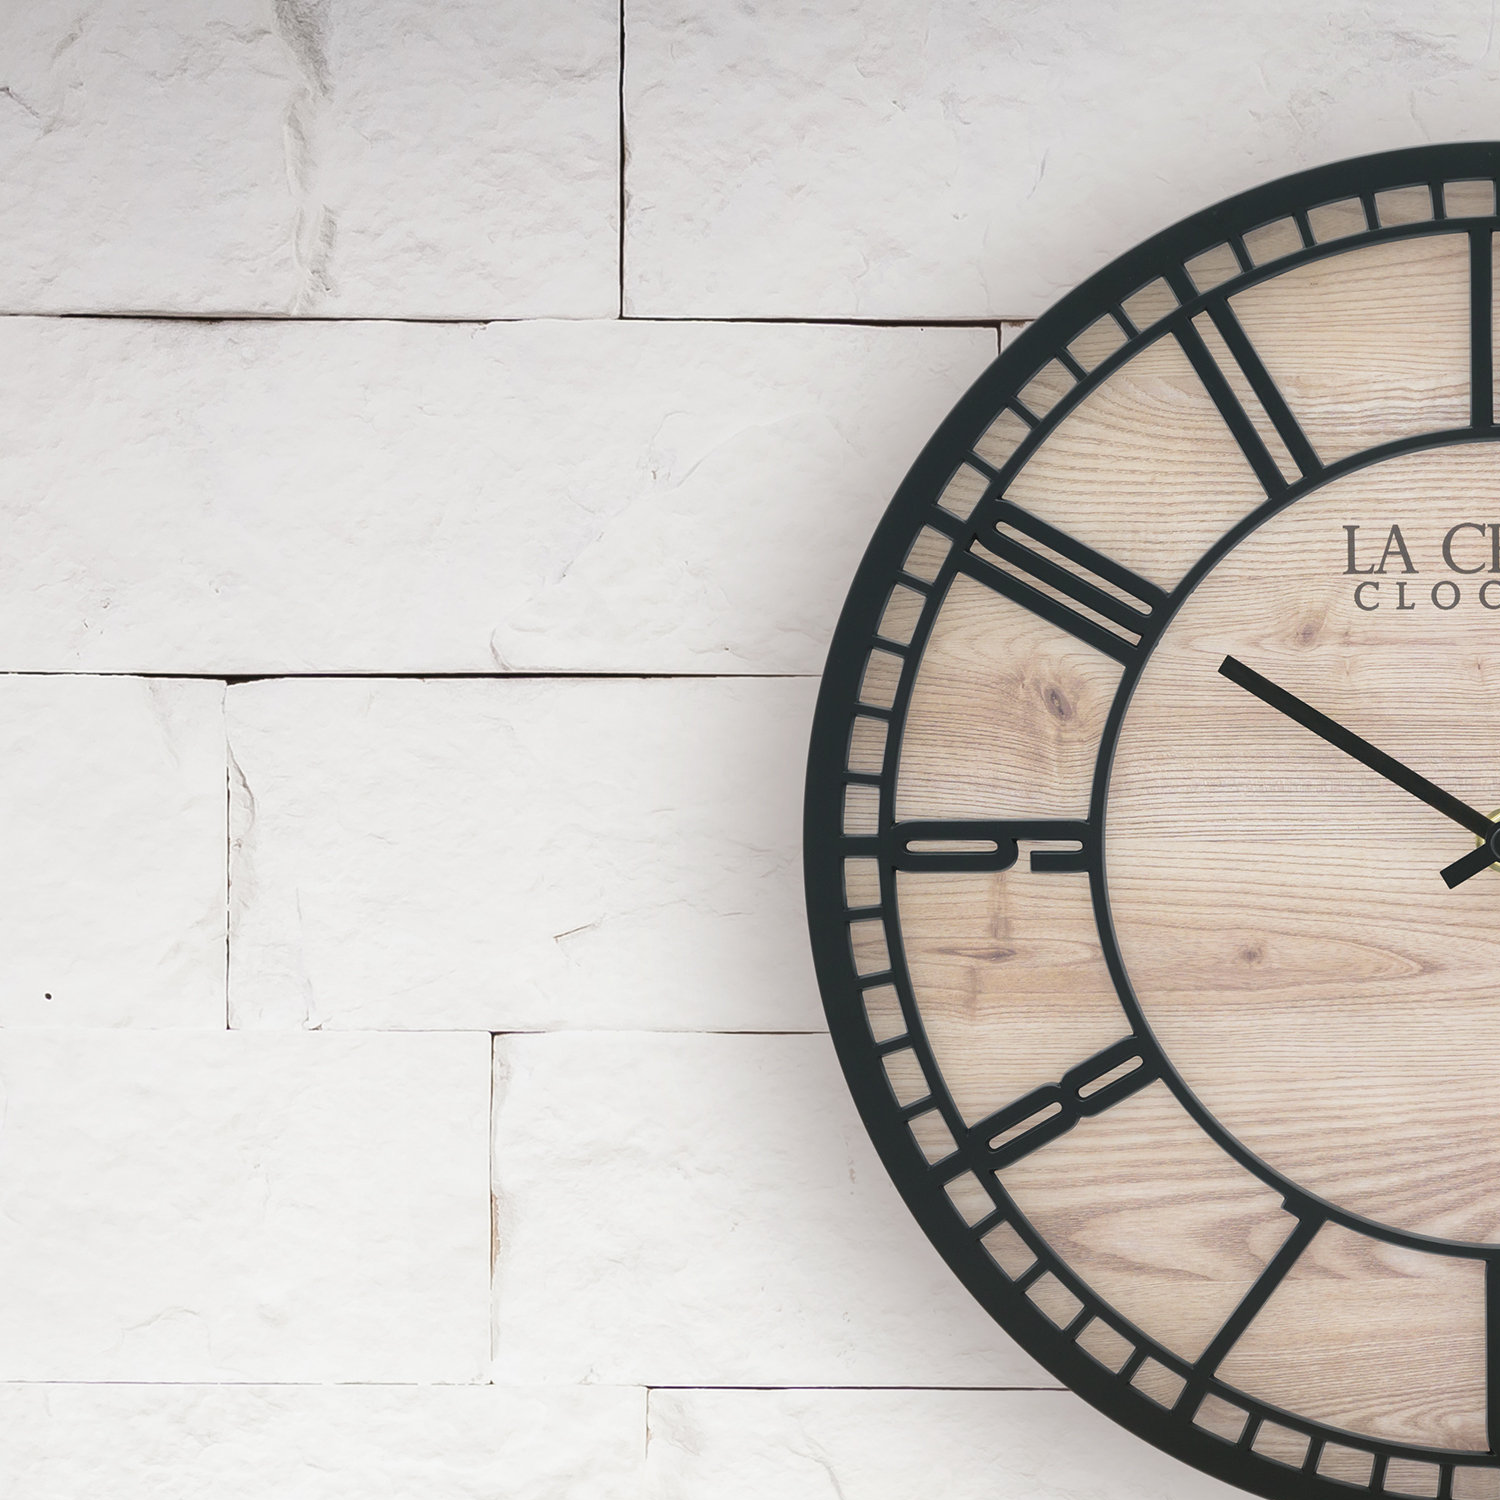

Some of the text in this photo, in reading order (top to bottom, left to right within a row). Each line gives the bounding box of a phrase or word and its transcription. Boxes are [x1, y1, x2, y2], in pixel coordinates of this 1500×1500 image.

[1166, 298, 1324, 506] 11
[960, 497, 1172, 670] 10
[1342, 524, 1419, 575] LA
[892, 820, 1094, 873] 9
[966, 1034, 1164, 1173] 8
[1192, 1196, 1328, 1378] 7
